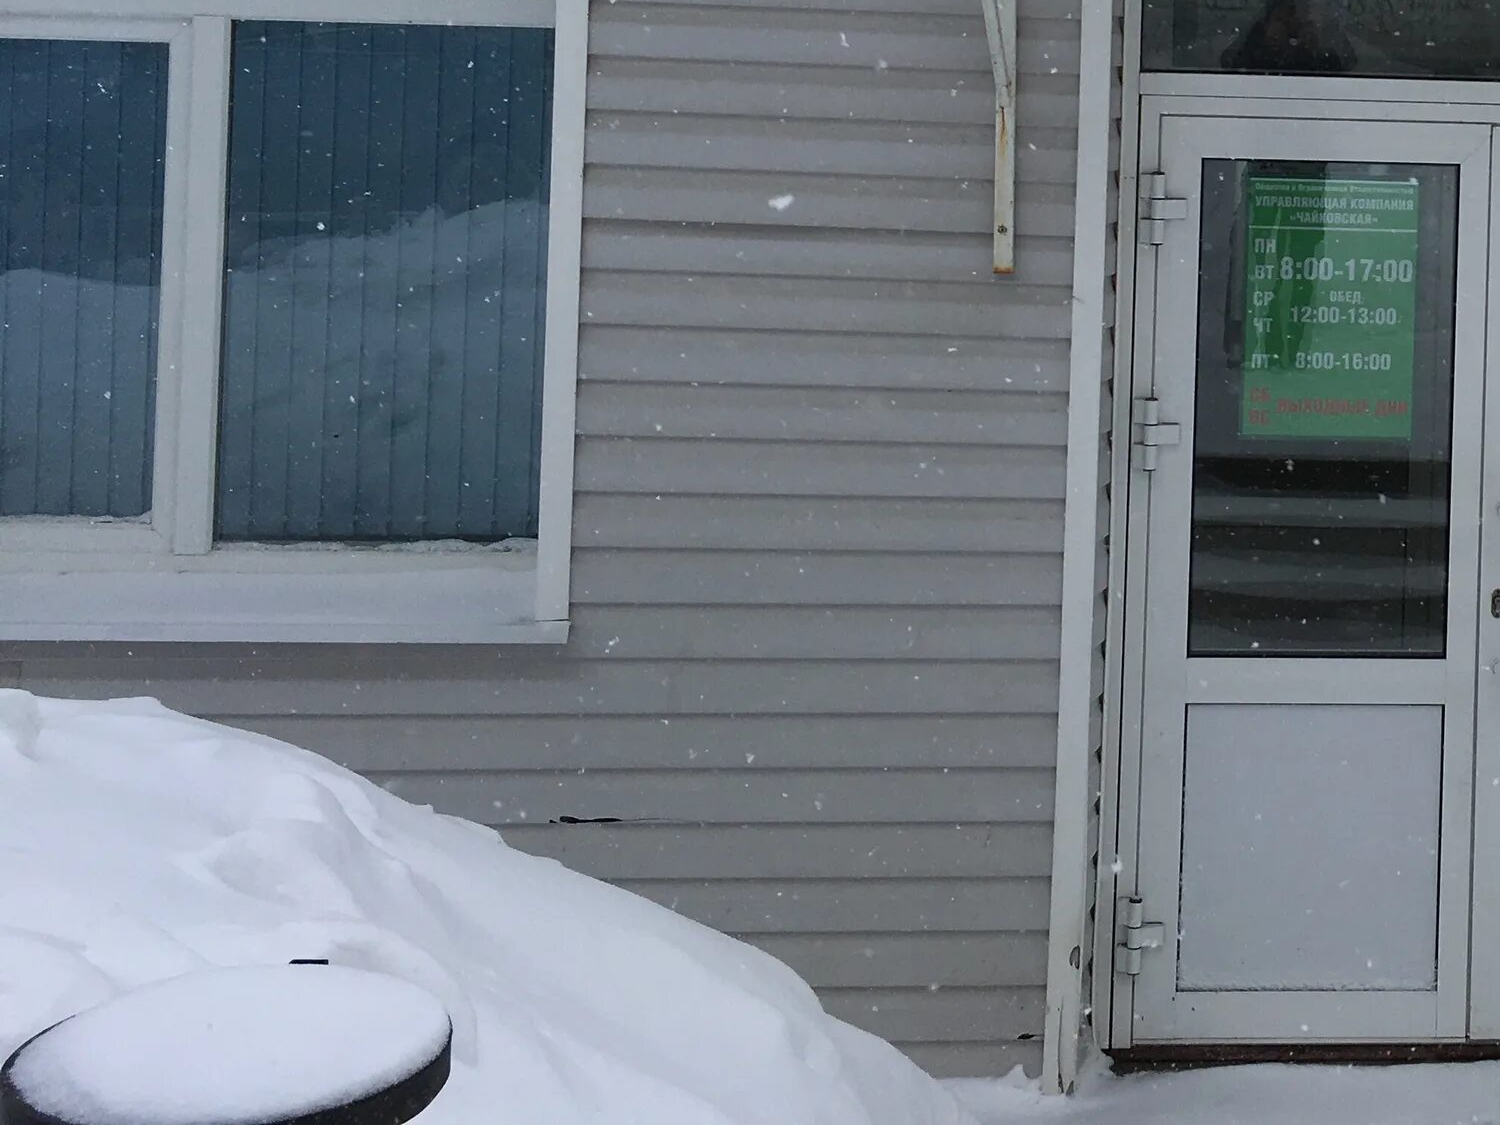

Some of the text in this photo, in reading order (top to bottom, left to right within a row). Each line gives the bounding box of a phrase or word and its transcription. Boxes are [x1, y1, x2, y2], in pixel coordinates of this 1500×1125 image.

[1255, 195, 1414, 211] УПРАВЛЯЮЩАЯ КОМПАНИЯ
[1254, 238, 1276, 254] ПН
[1254, 264, 1275, 280] ВТ
[1279, 256, 1414, 283] 8:00-17:00
[1253, 290, 1274, 306] СР
[1291, 306, 1397, 325] 12:00-13:00
[1253, 317, 1274, 333] ЧТ
[1251, 353, 1270, 369] ПТ
[1295, 352, 1391, 371] 8:00-16:00
